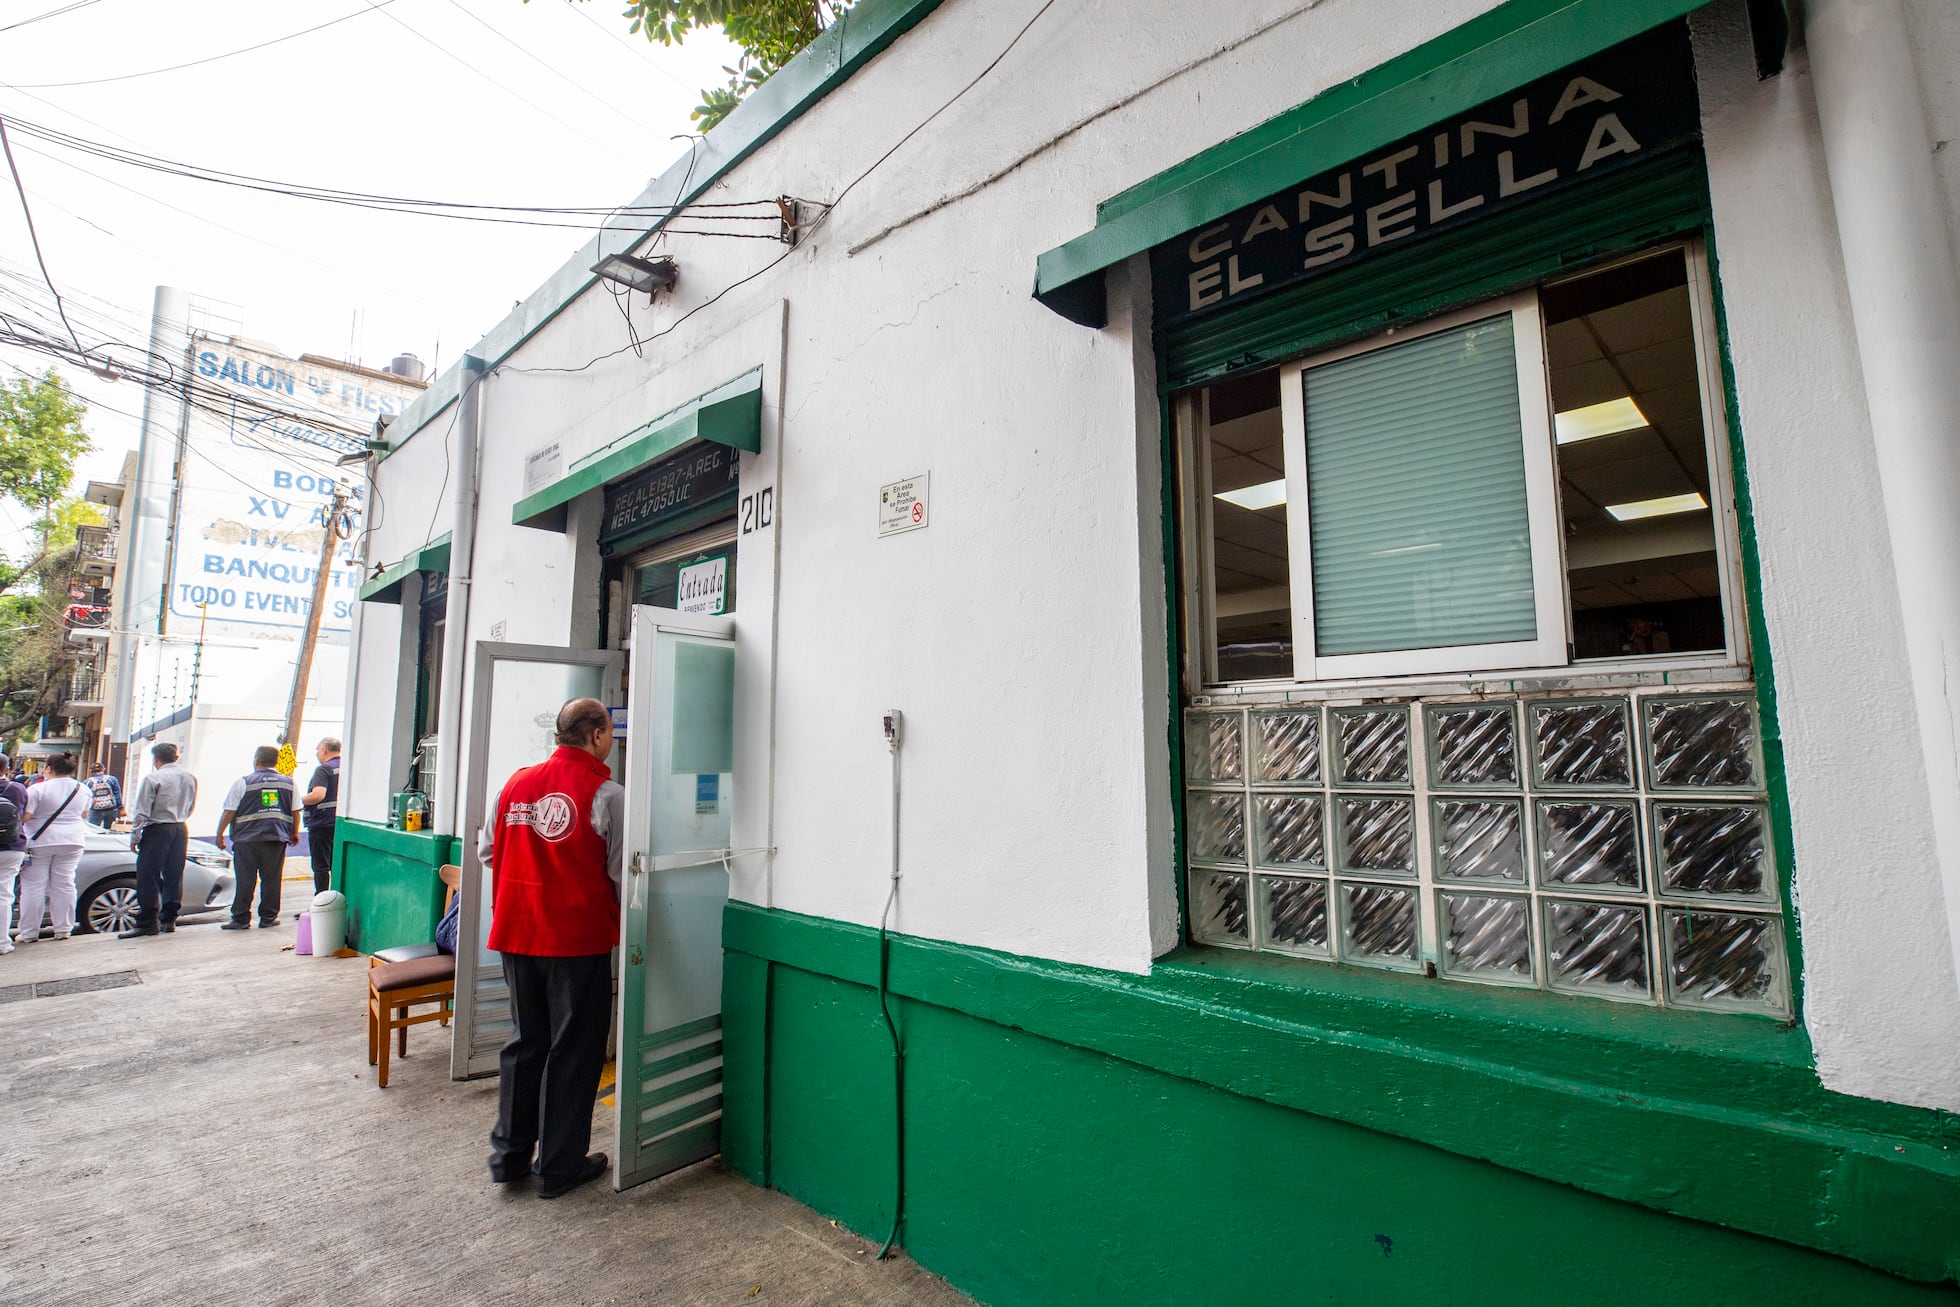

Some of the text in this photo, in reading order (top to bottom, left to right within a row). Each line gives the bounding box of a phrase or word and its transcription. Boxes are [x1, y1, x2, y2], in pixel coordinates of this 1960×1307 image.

[1189, 76, 1624, 264] CANTINA
[1189, 112, 1642, 312] EL SELLA
[199, 351, 294, 395] SALON
[248, 496, 291, 519] XV
[611, 505, 639, 530] MERC
[742, 486, 773, 534] 210
[180, 584, 236, 607] TODO
[245, 592, 313, 616] EVENT
[680, 563, 723, 601] Entrada
